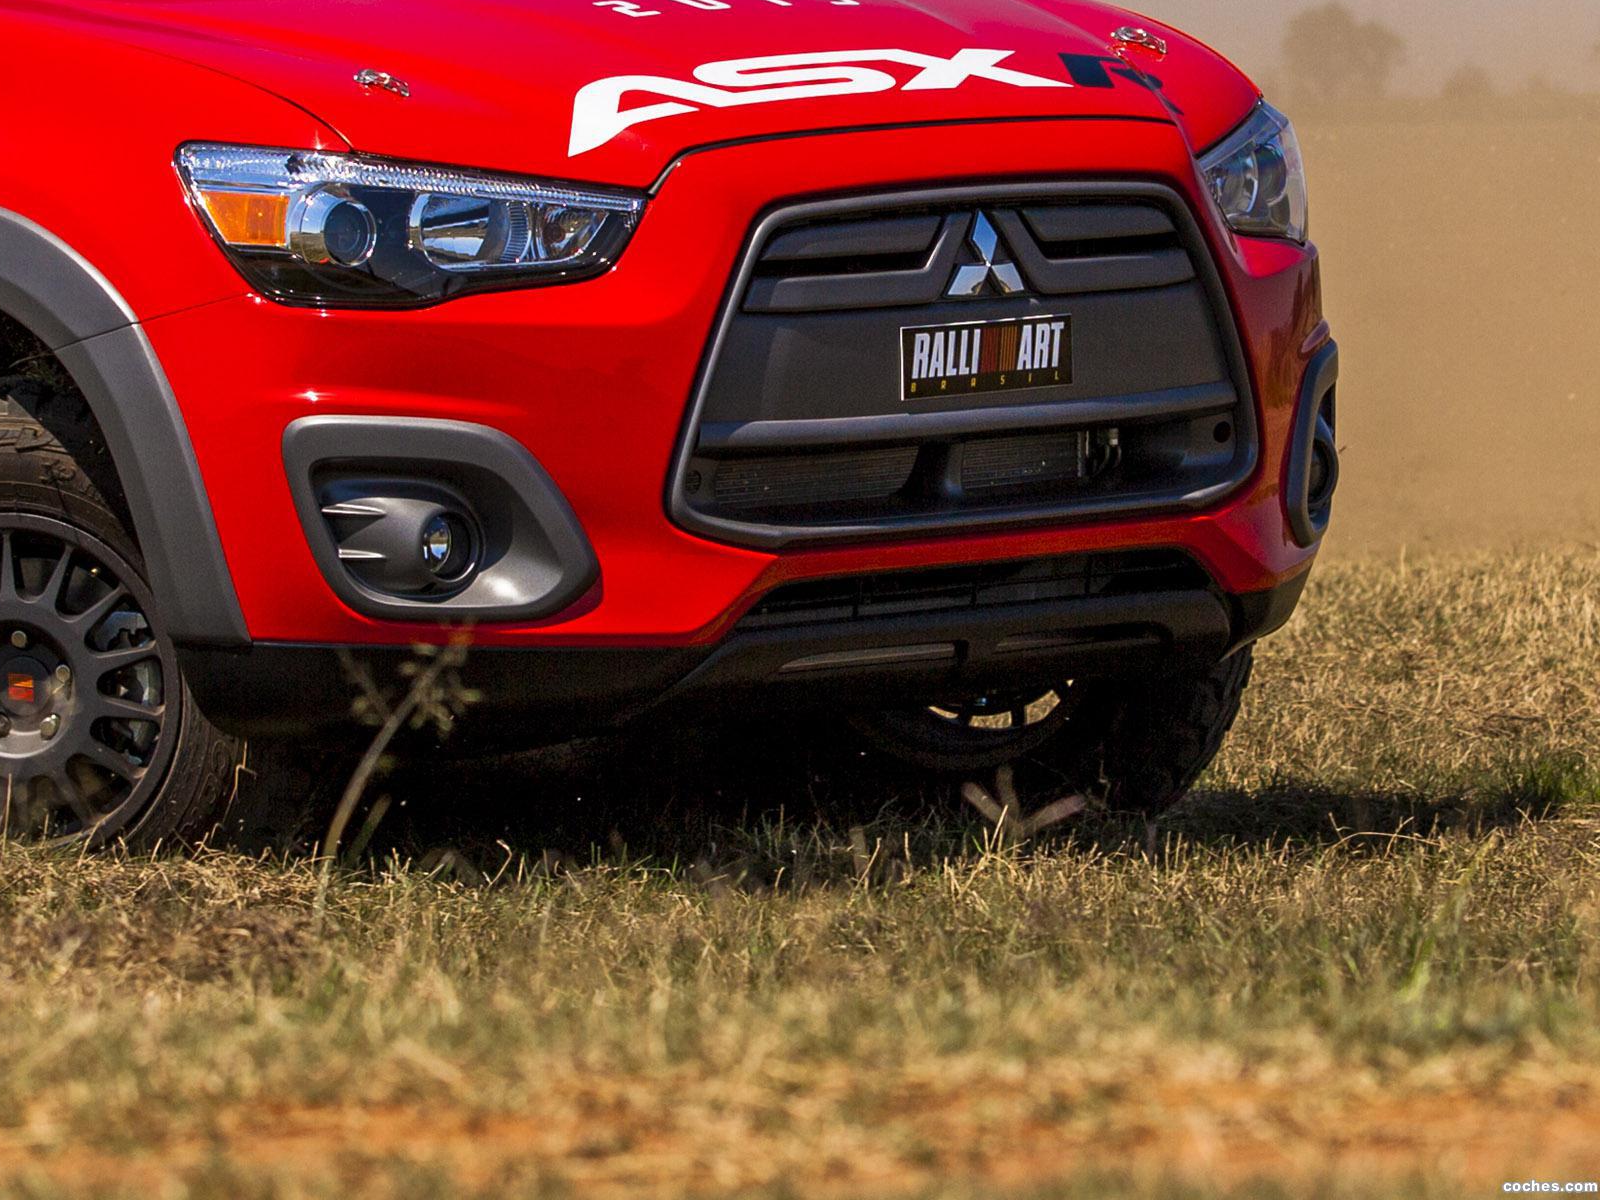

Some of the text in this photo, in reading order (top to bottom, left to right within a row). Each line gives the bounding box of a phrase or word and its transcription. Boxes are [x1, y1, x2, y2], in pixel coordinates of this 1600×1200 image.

[568, 48, 1075, 157] ASX
[911, 321, 1065, 380] RALLI ART
[910, 372, 1060, 393] BRASIL
